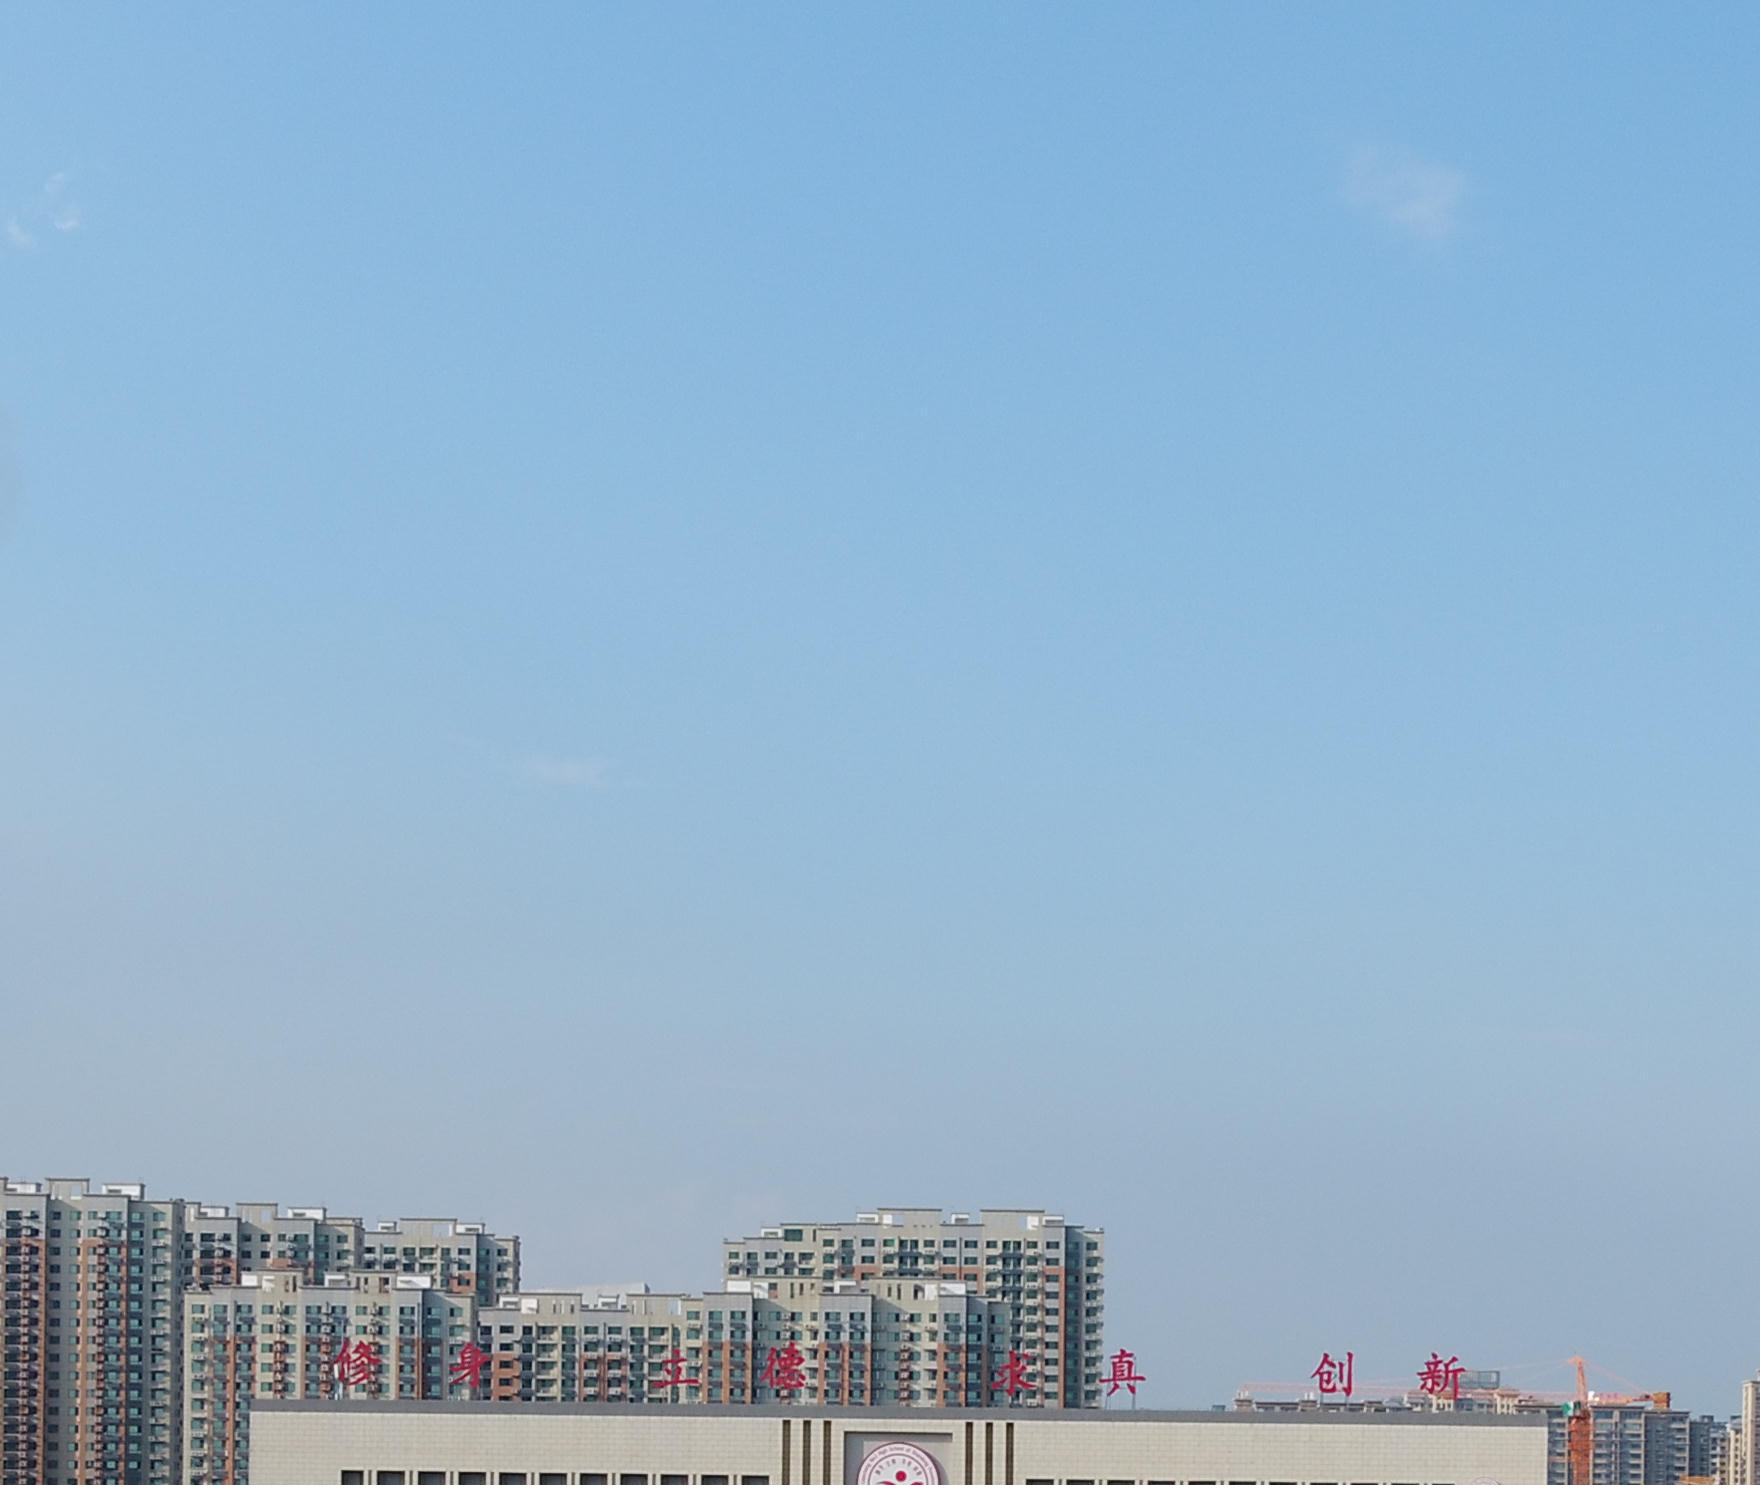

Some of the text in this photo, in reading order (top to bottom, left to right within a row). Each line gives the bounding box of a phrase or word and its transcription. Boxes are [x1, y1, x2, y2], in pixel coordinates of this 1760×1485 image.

[335, 1341, 1466, 1400] 修身 立德 求真 创新
